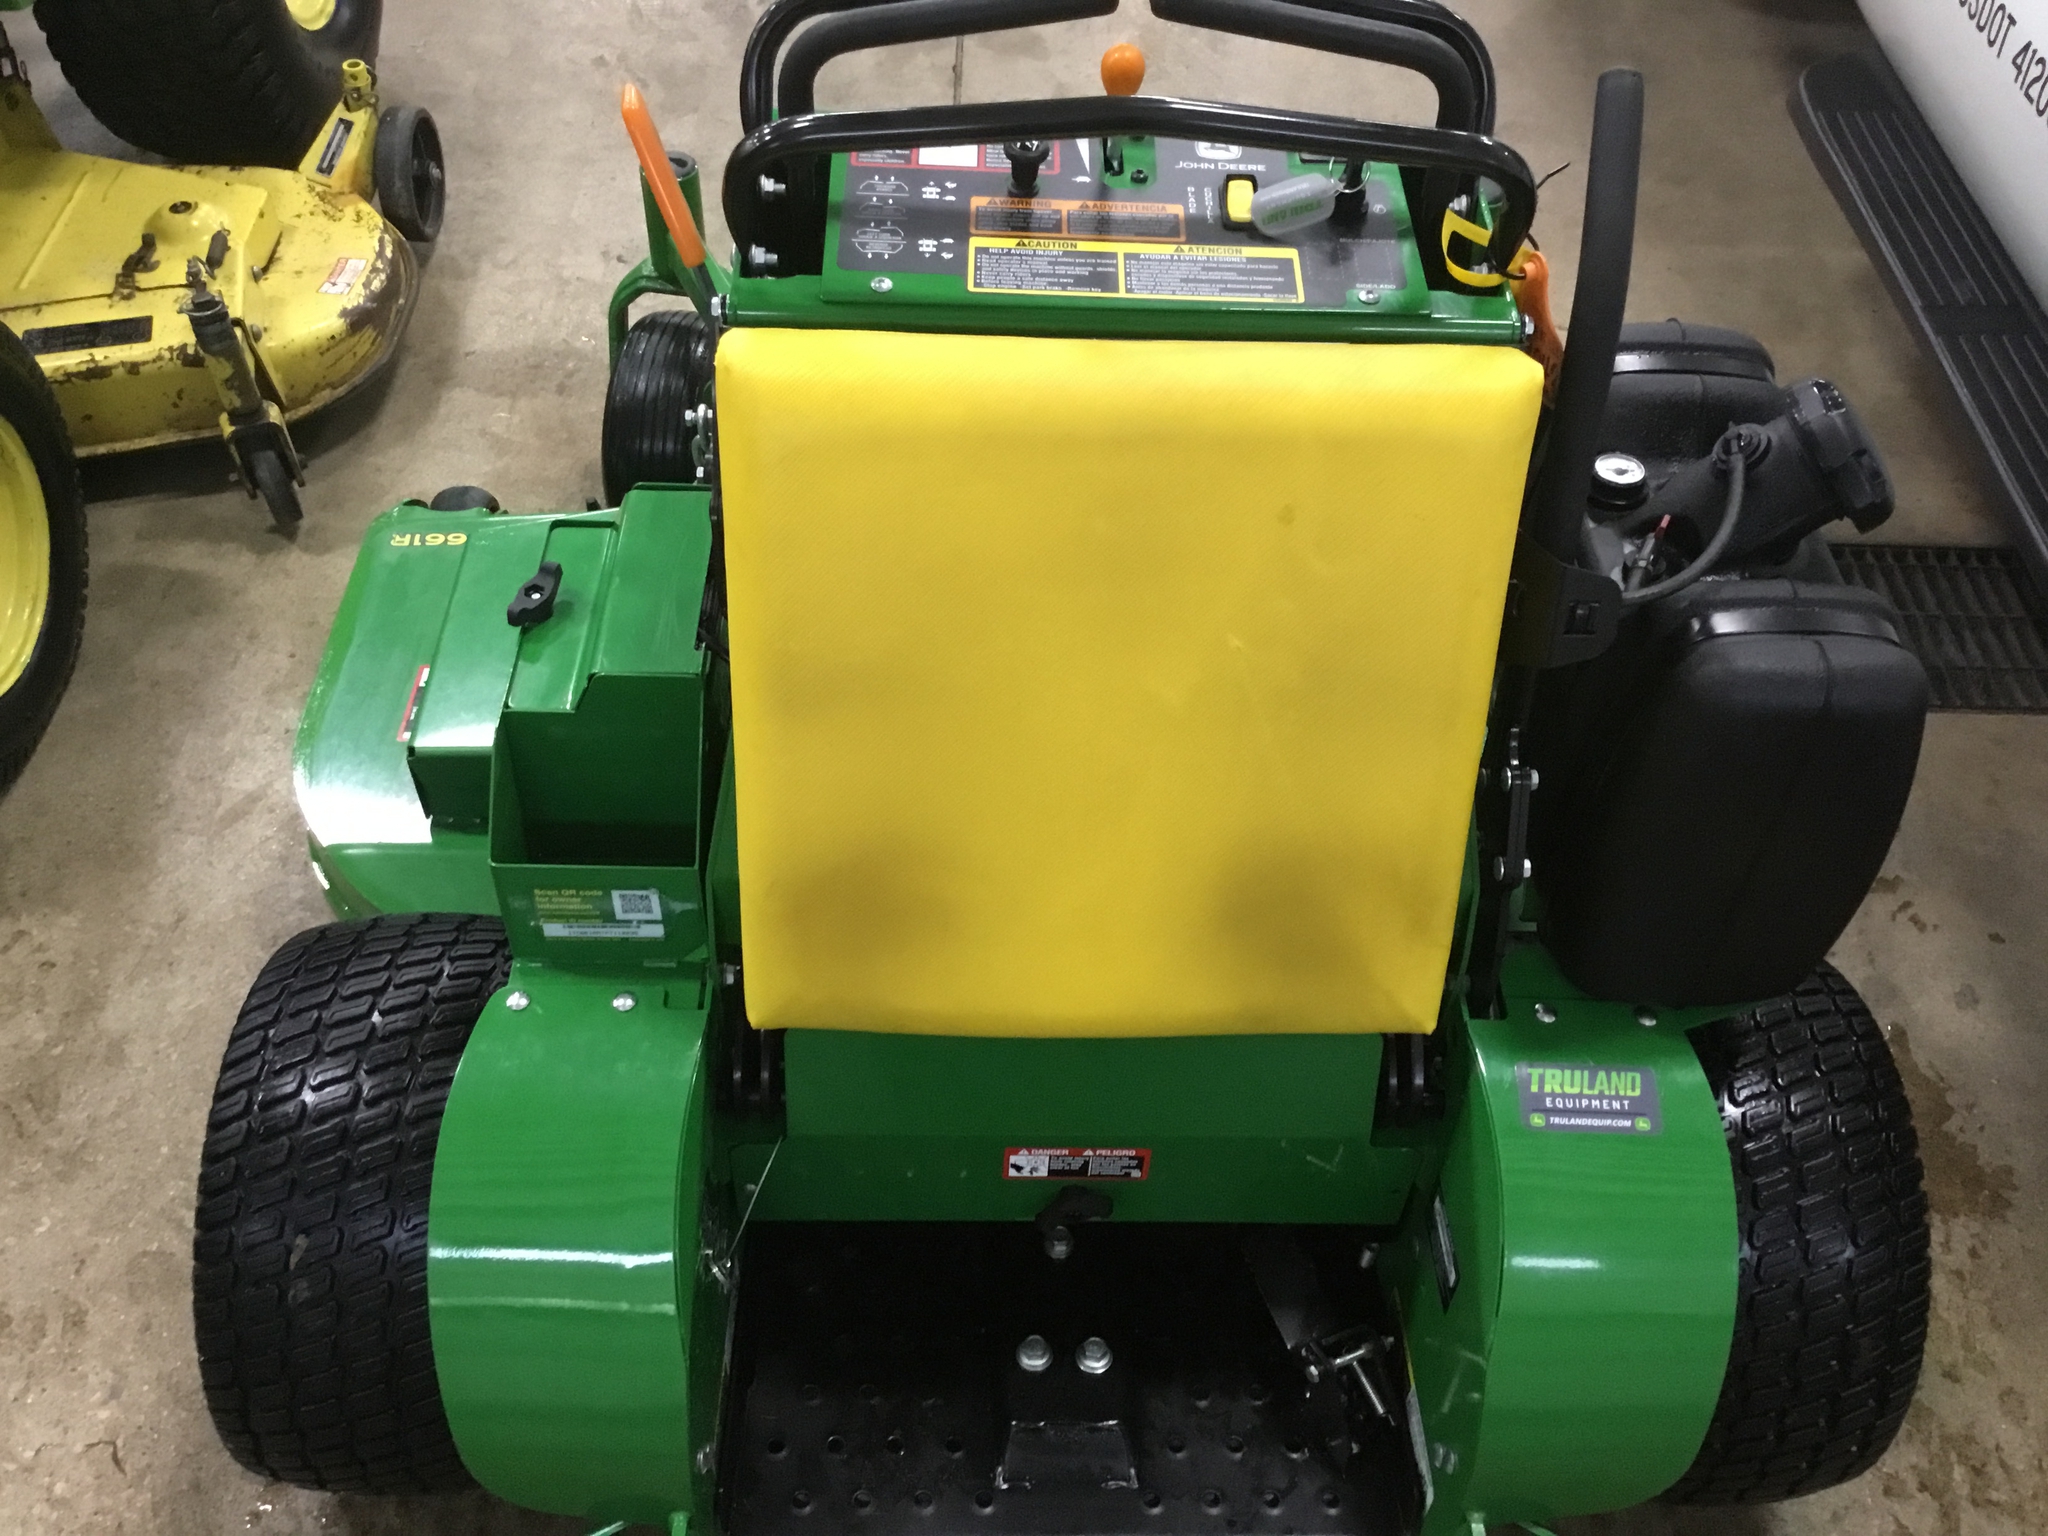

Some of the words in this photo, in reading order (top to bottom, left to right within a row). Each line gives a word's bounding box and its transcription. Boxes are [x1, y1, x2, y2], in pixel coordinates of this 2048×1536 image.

[1175, 161, 1214, 170] JOHN
[1217, 162, 1266, 171] DEERE
[1000, 199, 1052, 208] WARNING
[1187, 187, 1196, 214] BLADE
[1092, 202, 1167, 212] ADVERTENCIA
[1028, 241, 1078, 249] CAUTION
[390, 532, 468, 546] 661R
[1527, 1068, 1642, 1097] TRULAND
[1546, 1097, 1630, 1110] EQUIPMENT
[1550, 1117, 1632, 1127] TRULANDEQUIP.COM
